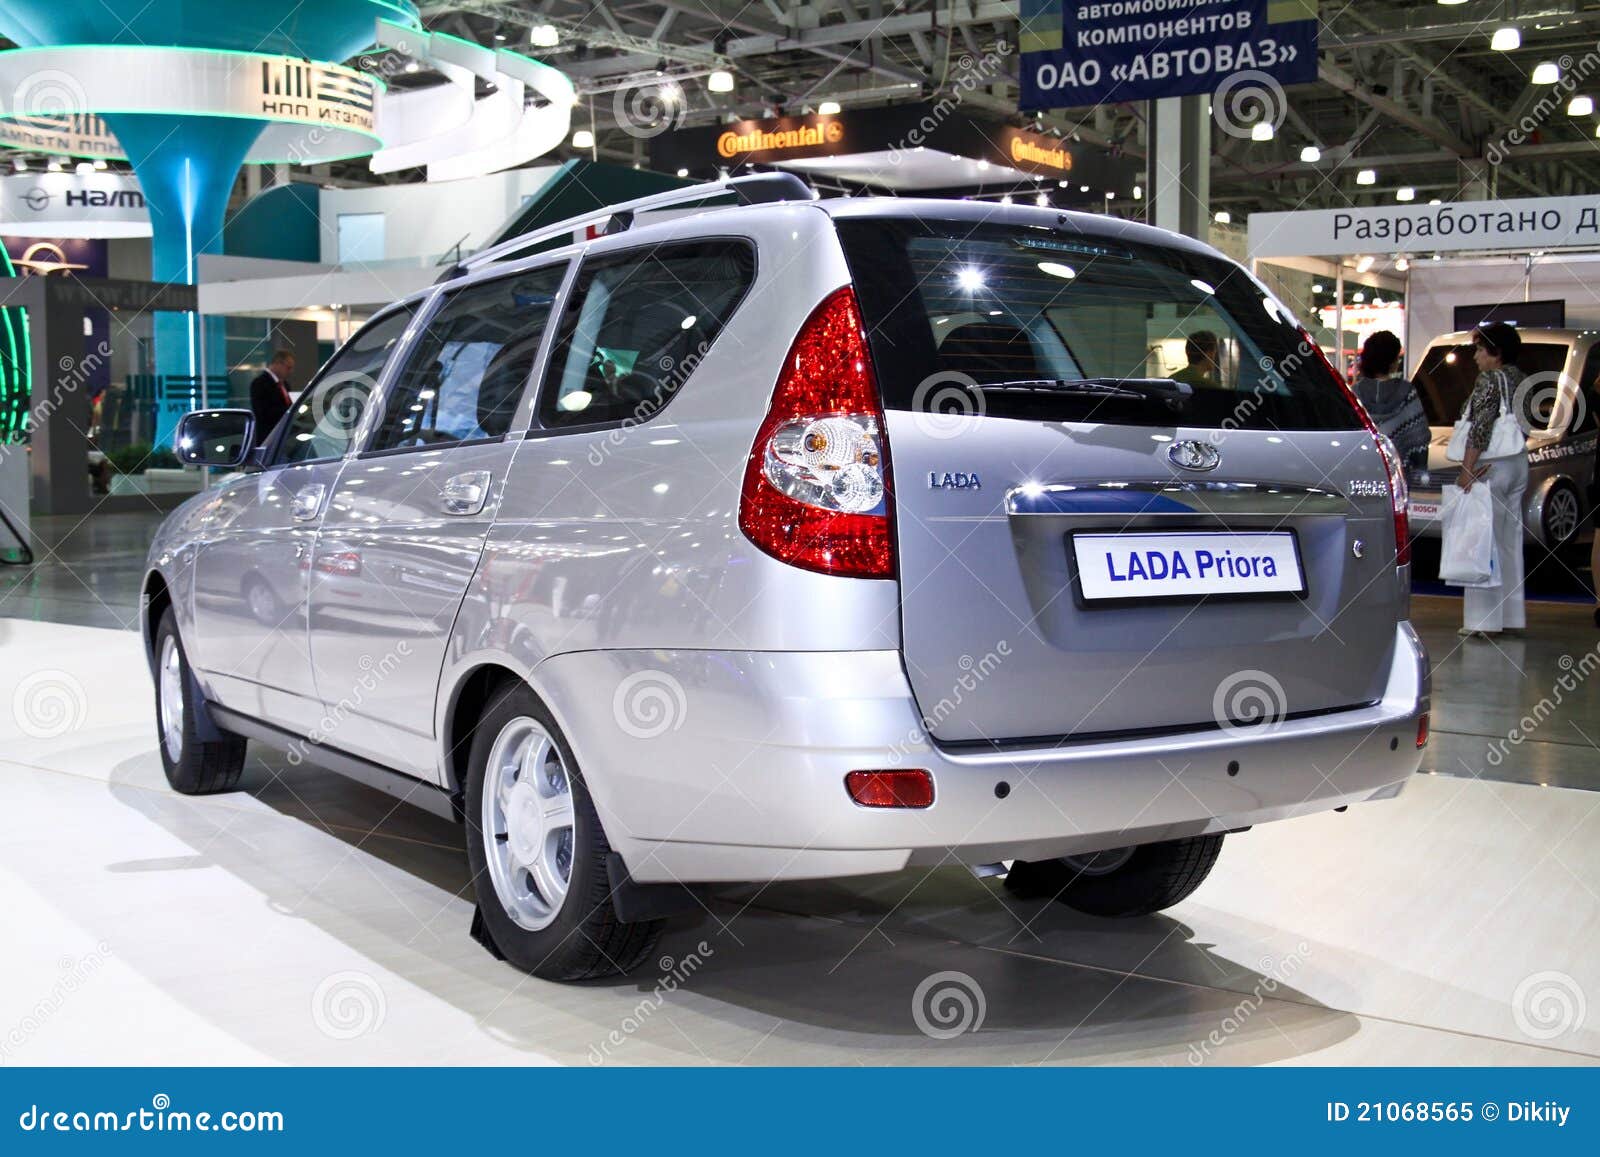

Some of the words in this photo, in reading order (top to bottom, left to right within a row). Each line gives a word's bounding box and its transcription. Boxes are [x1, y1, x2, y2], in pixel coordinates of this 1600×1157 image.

[1077, 0, 1230, 20] автомобил
[1077, 11, 1251, 48] компонентов
[1036, 59, 1101, 90] ОАО
[1110, 39, 1298, 82] «АВТОВАЗ»
[262, 101, 308, 117] НПП
[717, 122, 825, 158] Continental
[1333, 207, 1562, 243] Разработано
[927, 471, 982, 489] LADA
[1106, 551, 1192, 582] LADA
[1195, 550, 1277, 579] Priora
